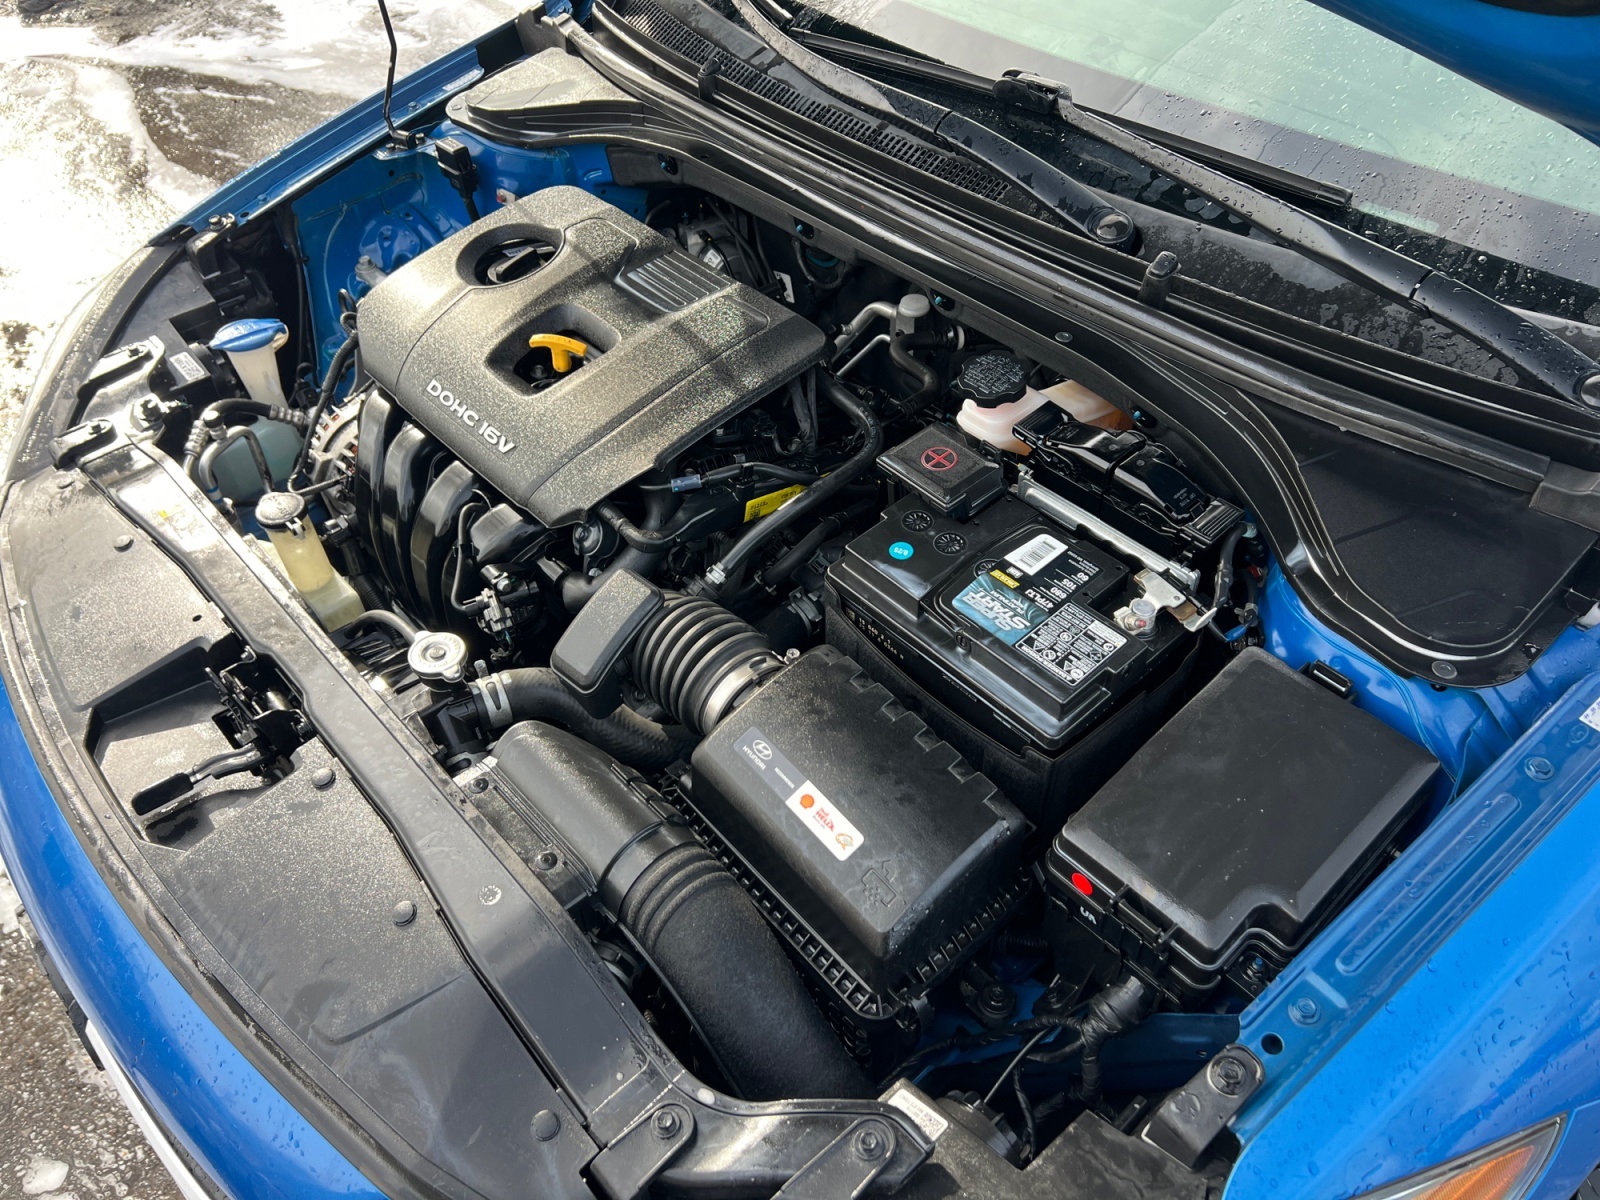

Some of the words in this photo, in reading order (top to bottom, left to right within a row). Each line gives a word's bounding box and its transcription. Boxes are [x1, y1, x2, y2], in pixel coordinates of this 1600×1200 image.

[426, 380, 479, 427] DOHC
[478, 421, 515, 454] 16V
[1061, 578, 1077, 590] 105
[1076, 572, 1089, 581] 60
[990, 591, 1025, 614] PLATINUM
[1024, 589, 1054, 608] 47PLTJ
[1050, 586, 1067, 599] 680
[962, 595, 1013, 630] SUPER
[968, 591, 1031, 629] START
[742, 745, 766, 770] HYUNDAI
[815, 808, 835, 831] HELIX
